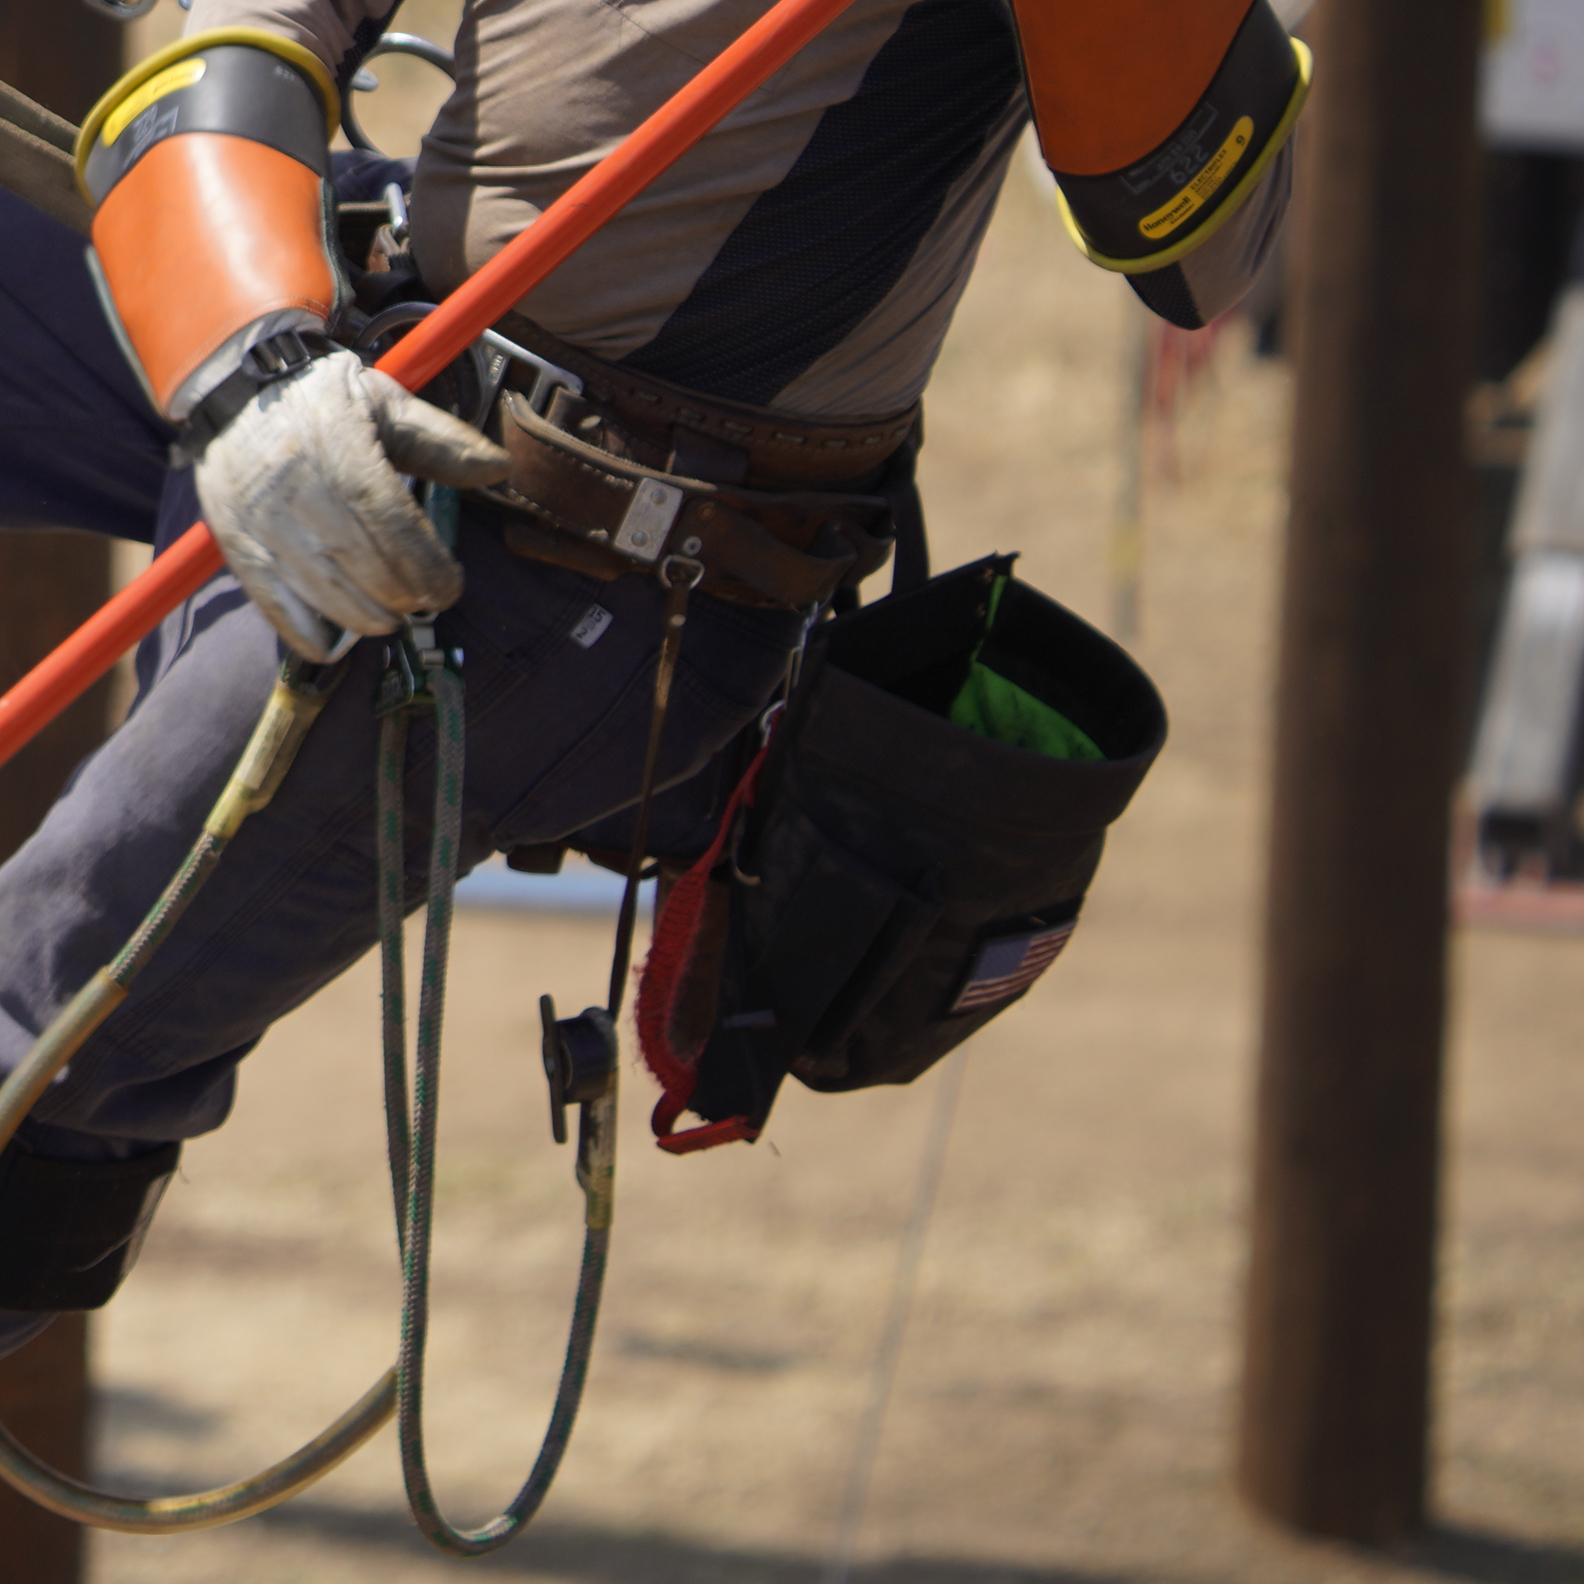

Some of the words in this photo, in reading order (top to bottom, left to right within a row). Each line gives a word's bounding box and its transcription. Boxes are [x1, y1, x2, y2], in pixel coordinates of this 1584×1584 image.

[1170, 144, 1209, 184] 622
[1190, 148, 1228, 191] ELECTRIFLEX
[1143, 195, 1192, 232] Honeywell
